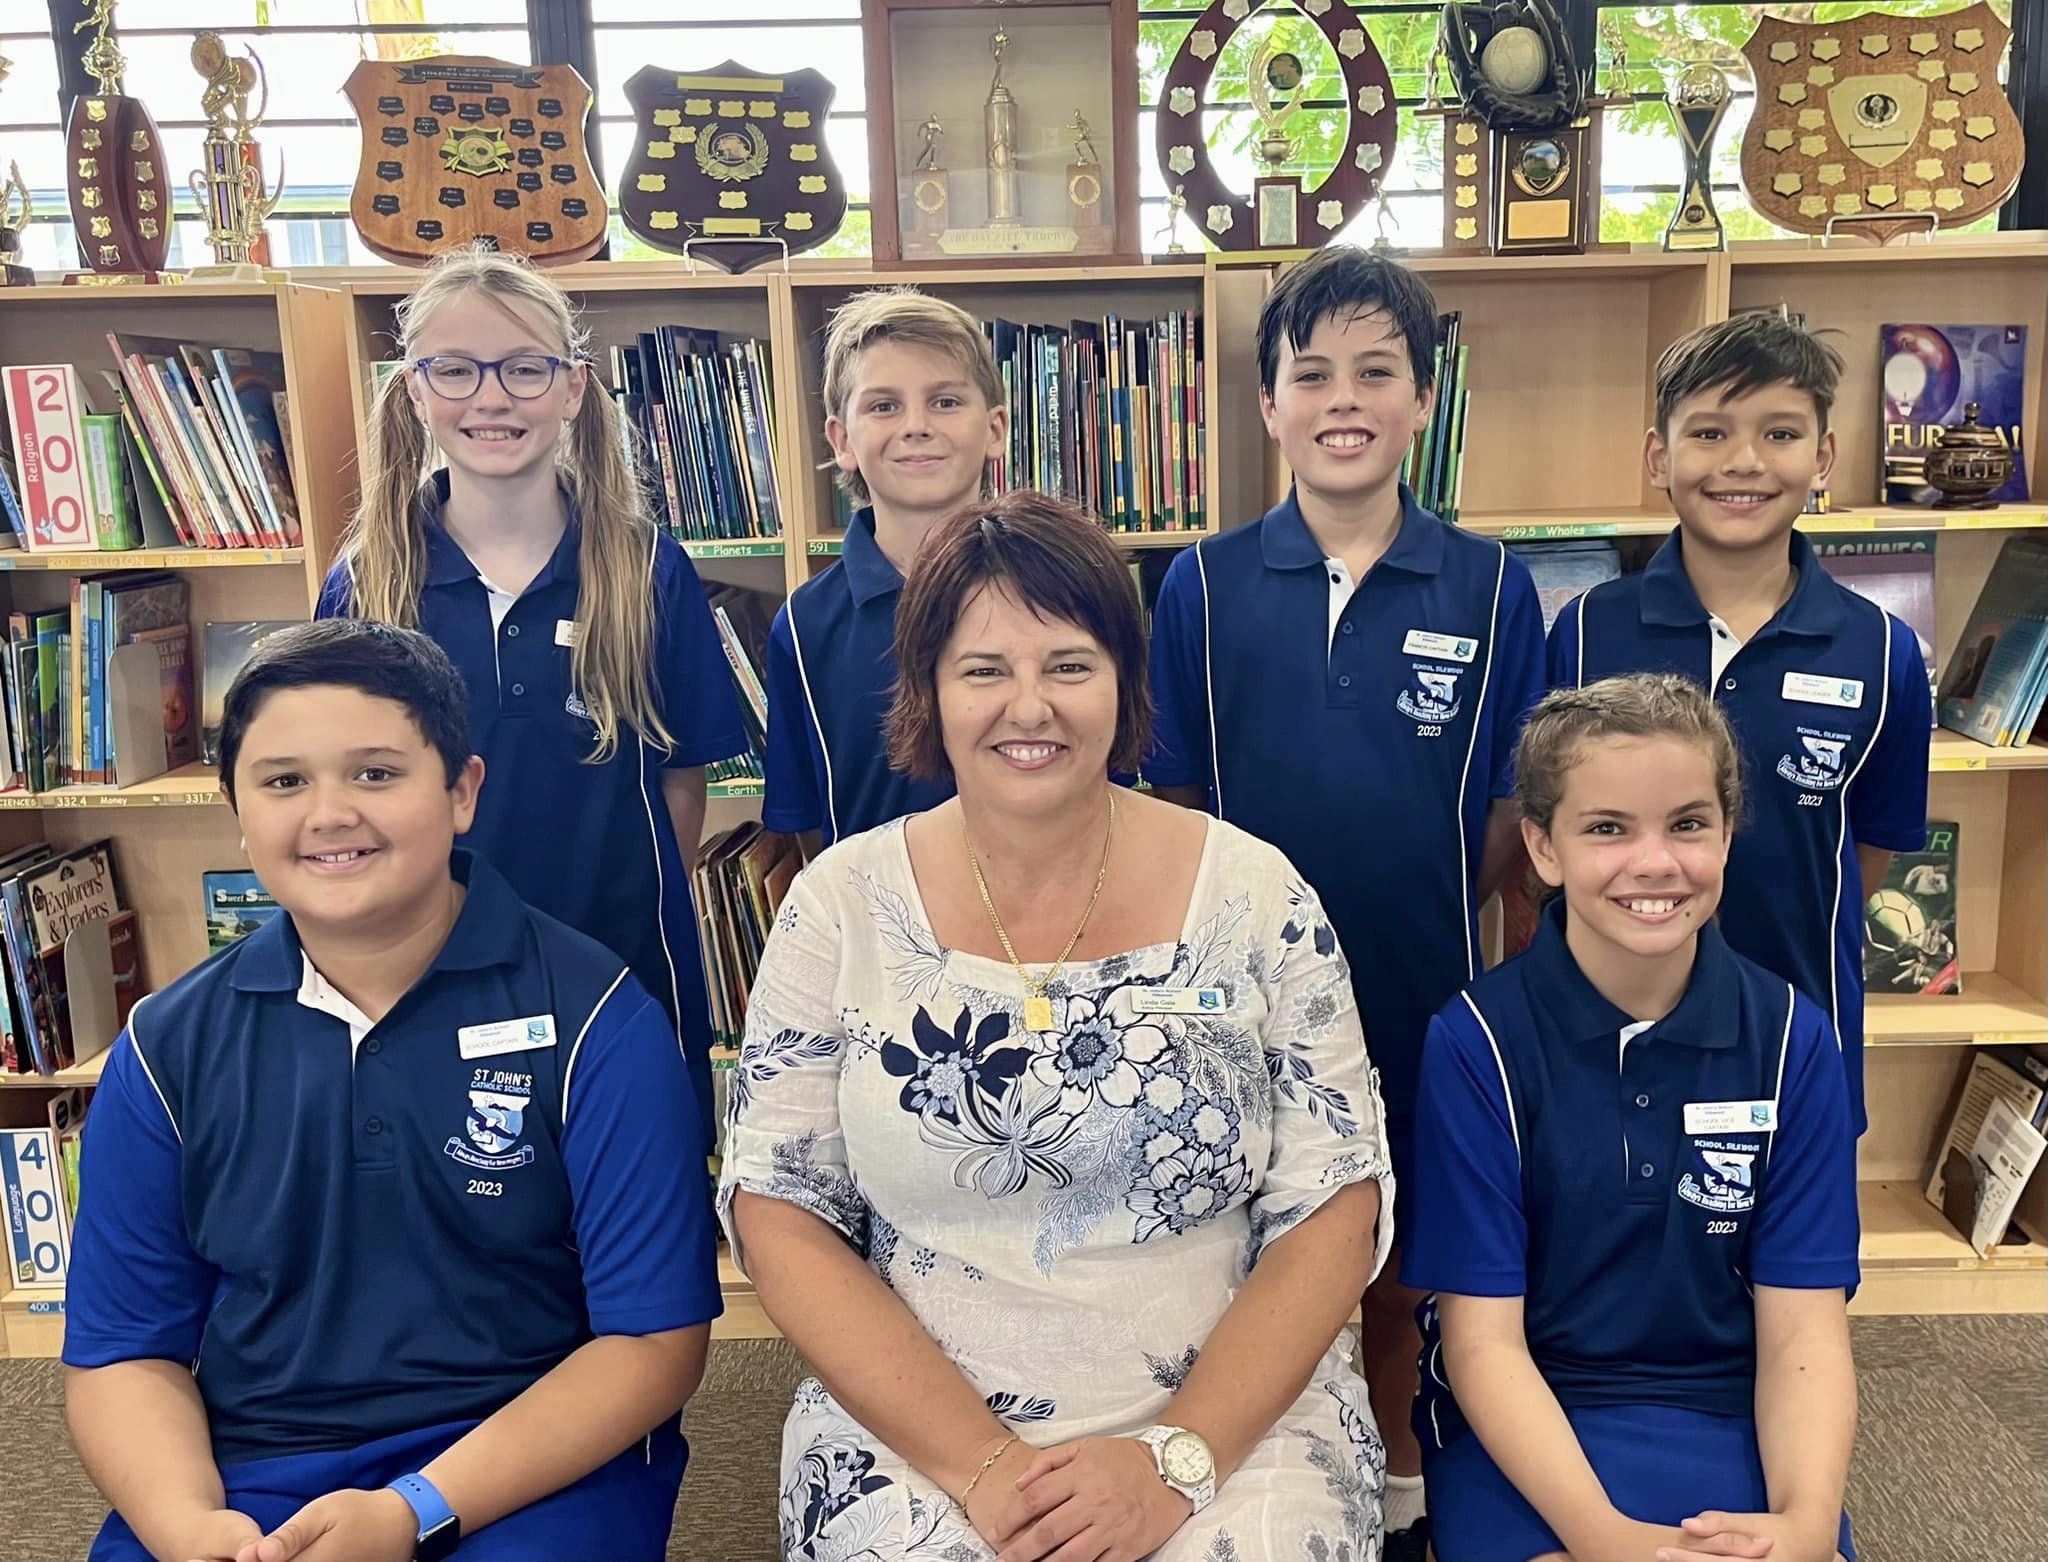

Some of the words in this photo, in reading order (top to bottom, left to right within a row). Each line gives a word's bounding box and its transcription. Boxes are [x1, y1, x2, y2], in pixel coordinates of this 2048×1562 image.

[740, 388, 756, 435] UNIVERSE
[23, 432, 40, 483] Religion
[713, 545, 752, 556] Planets
[809, 542, 828, 553] 591
[49, 558, 71, 568] 200
[80, 556, 145, 567] RELIGION
[1417, 725, 1442, 737] 2023
[727, 785, 757, 796] Earth
[56, 796, 87, 807] 332.4
[100, 796, 128, 806] Money
[1797, 794, 1823, 806] 2023
[43, 876, 104, 917] Explorers
[216, 888, 244, 902] Sweet
[49, 919, 61, 944] &
[62, 902, 110, 936] Traders
[474, 1068, 489, 1082] ST
[492, 1071, 533, 1088] JOHN'S
[470, 1080, 503, 1092] CATHOLIC
[504, 1084, 531, 1095] SCHOOL
[467, 1179, 503, 1196] 2023
[8, 1183, 24, 1233] Language
[1706, 1221, 1738, 1234] 2023
[29, 1303, 50, 1312] 400
